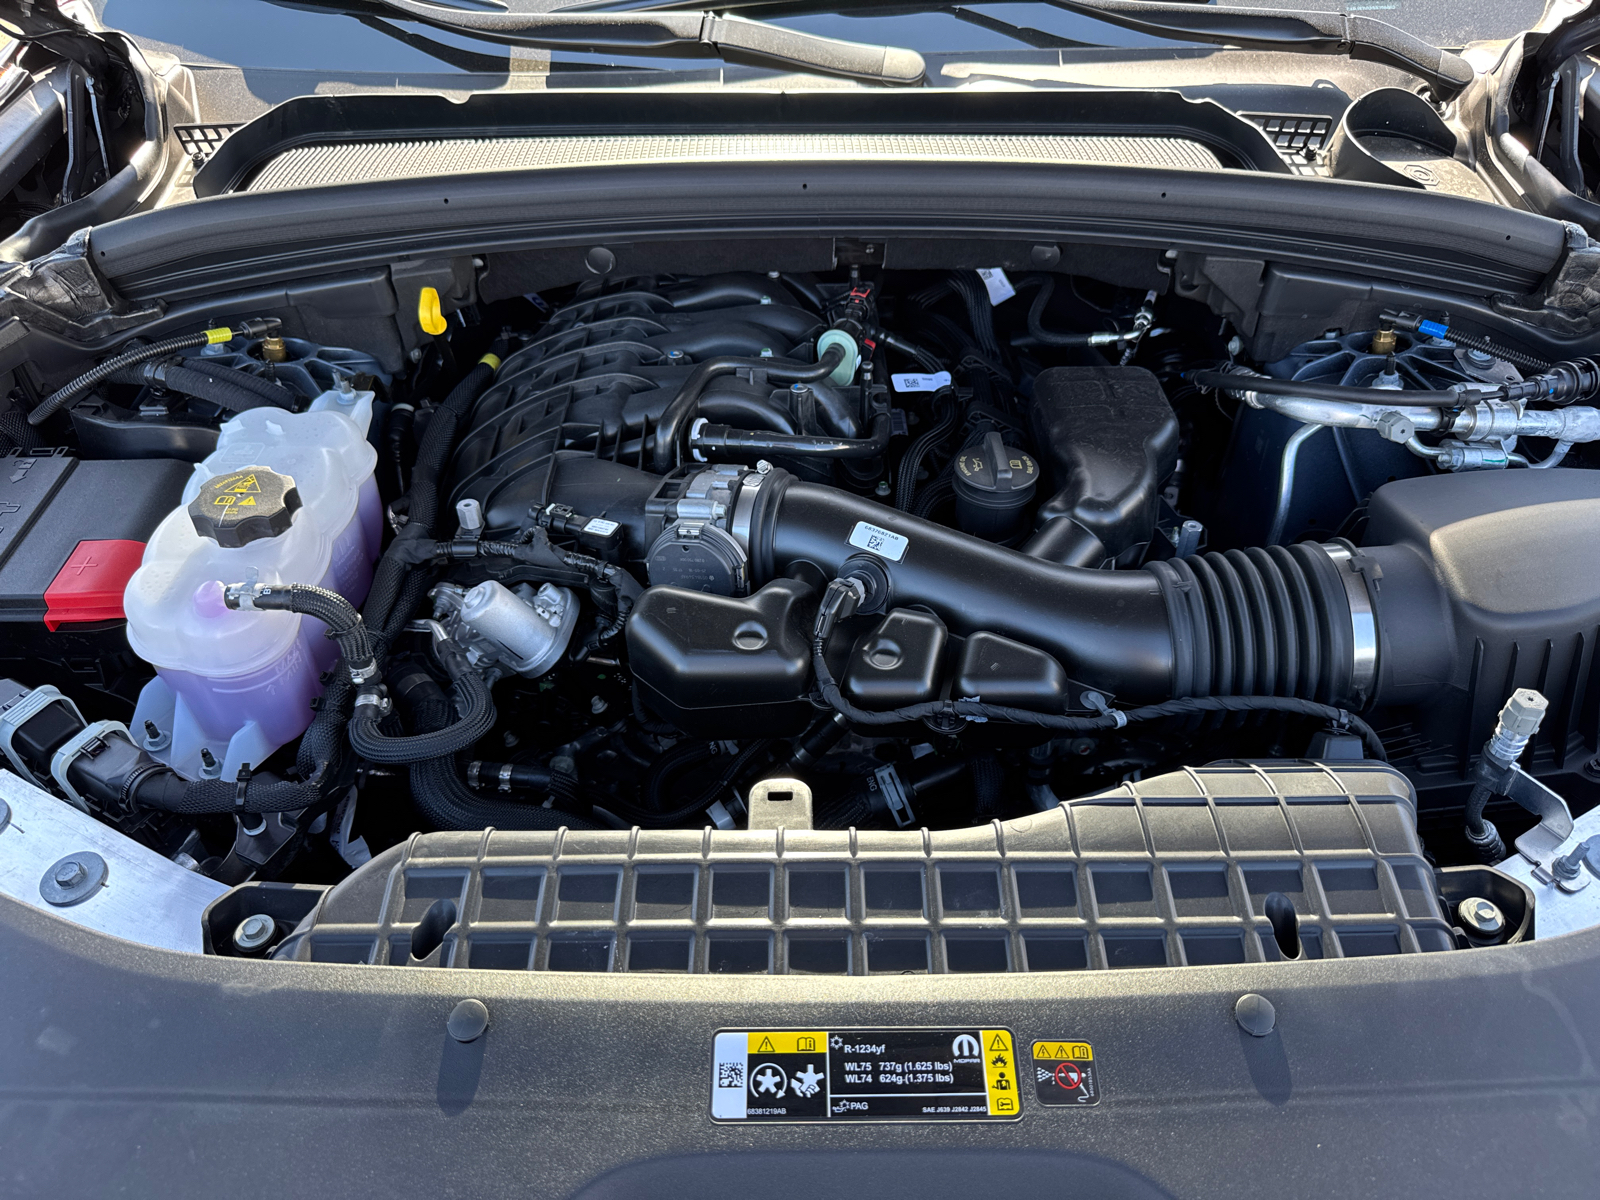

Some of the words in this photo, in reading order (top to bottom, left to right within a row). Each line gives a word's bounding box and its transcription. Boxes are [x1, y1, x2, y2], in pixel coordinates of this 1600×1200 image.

[844, 1044, 886, 1055] R-1234yf
[844, 1062, 872, 1071] WL75
[878, 1062, 902, 1073] 737g
[904, 1061, 933, 1072] (1.625
[934, 1061, 953, 1072] lbs)
[844, 1074, 873, 1083] WL74
[879, 1074, 903, 1085] 624g
[905, 1073, 934, 1085] (1.375
[935, 1073, 954, 1084] lbs)
[747, 1107, 787, 1115] 68381219AB
[850, 1102, 869, 1110] PAG
